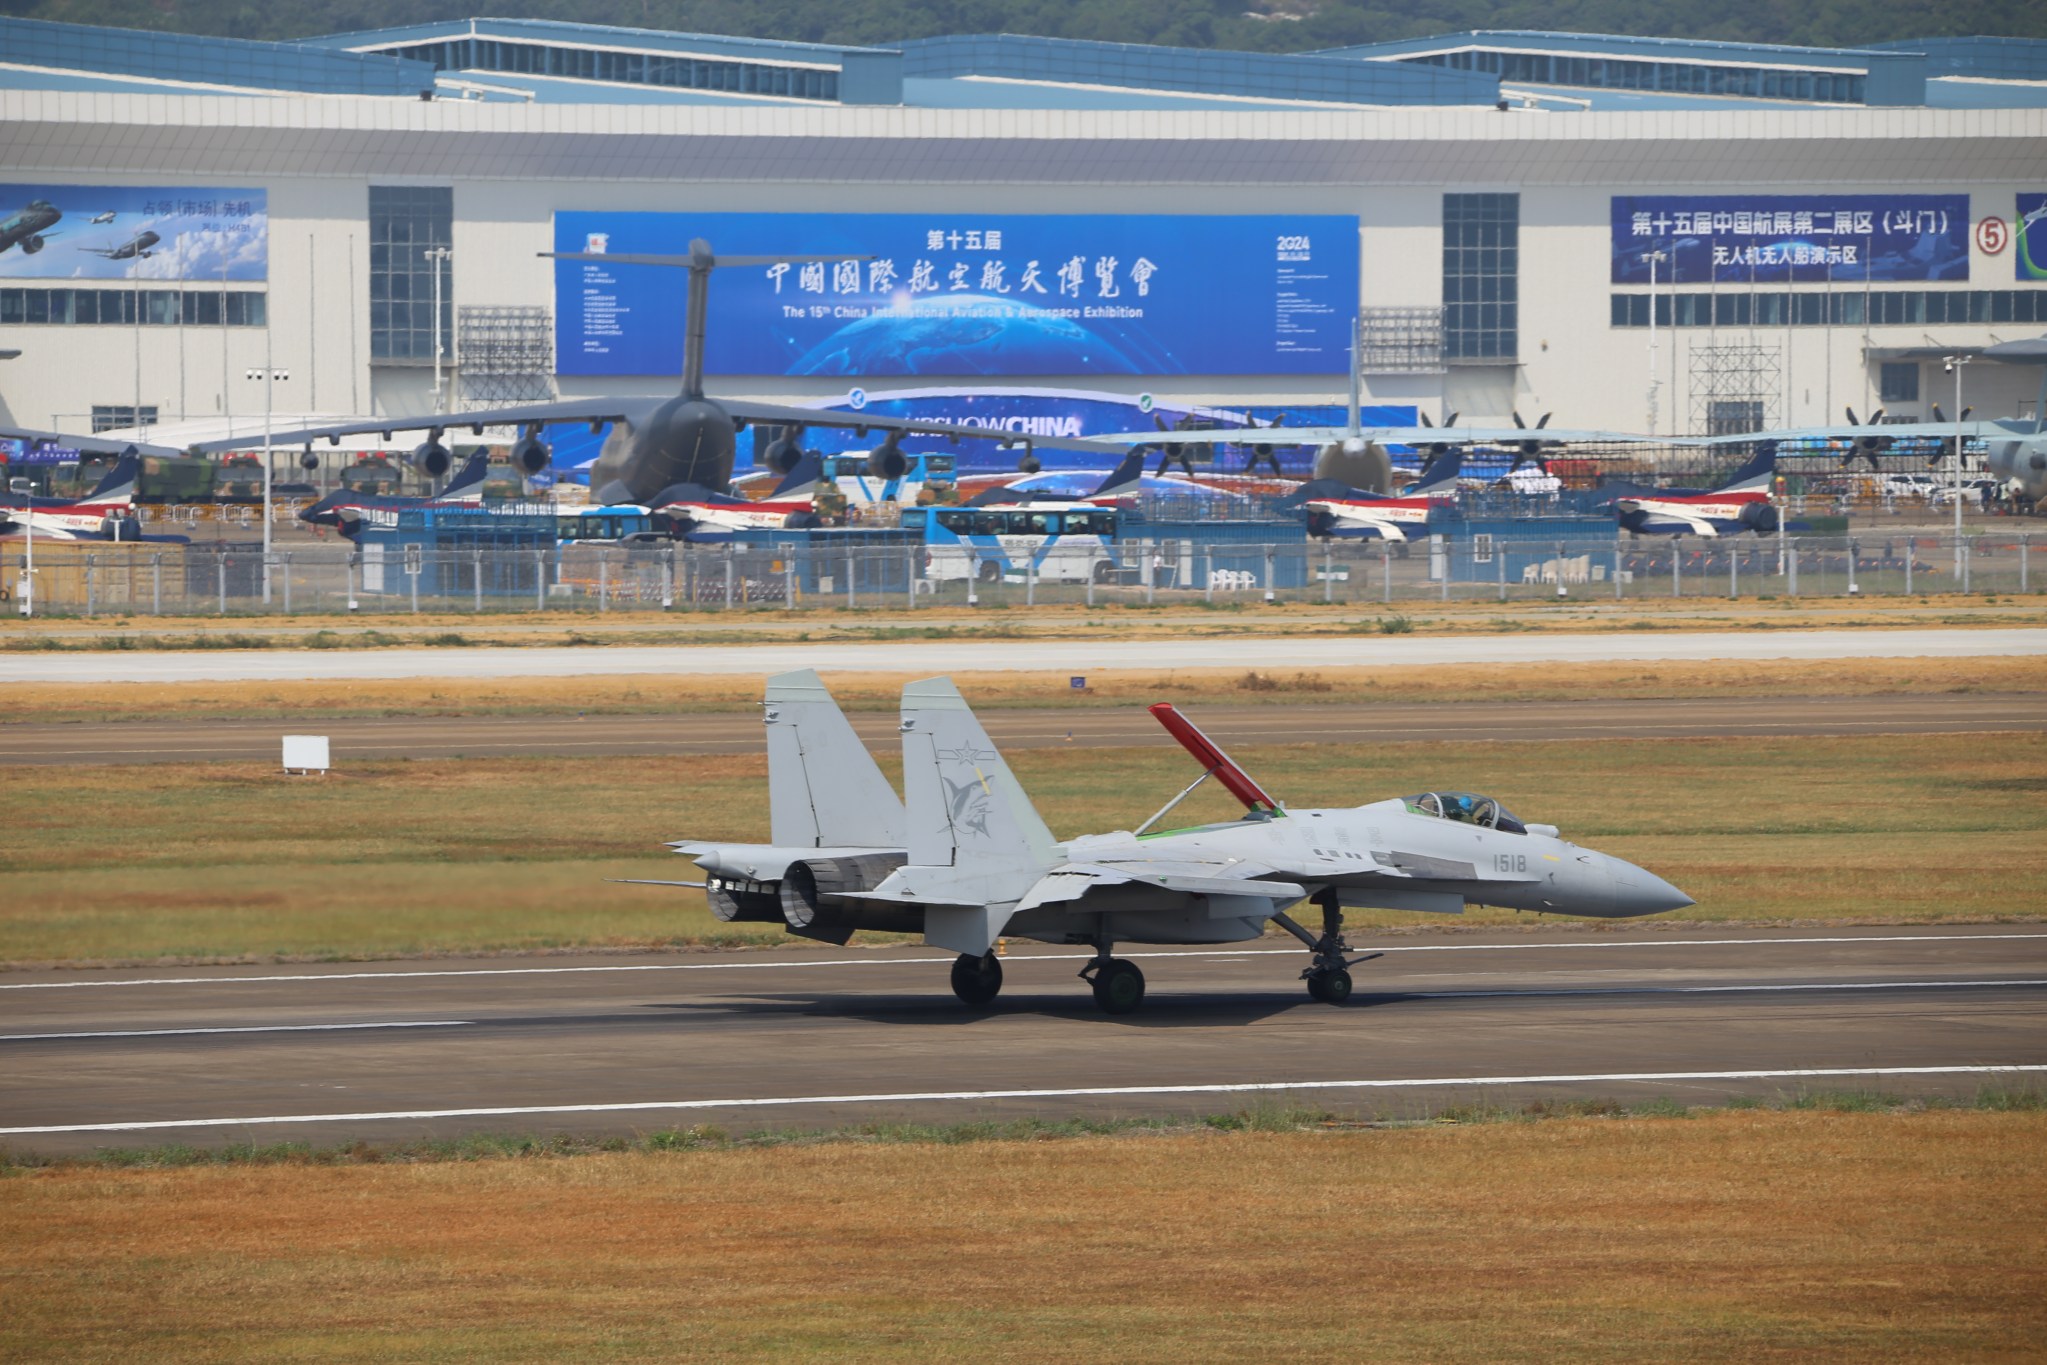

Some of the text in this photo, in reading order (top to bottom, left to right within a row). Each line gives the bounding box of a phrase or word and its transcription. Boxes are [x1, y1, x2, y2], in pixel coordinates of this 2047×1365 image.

[926, 230, 1002, 251] 第十五届
[1276, 235, 1310, 250] 2024
[1985, 220, 1999, 248] 5
[1713, 245, 1858, 266] 无人机无人船演示区
[783, 305, 1143, 320] The 15th China International Aviation & Aerospace Exhibition
[1494, 854, 1526, 872] 1518
